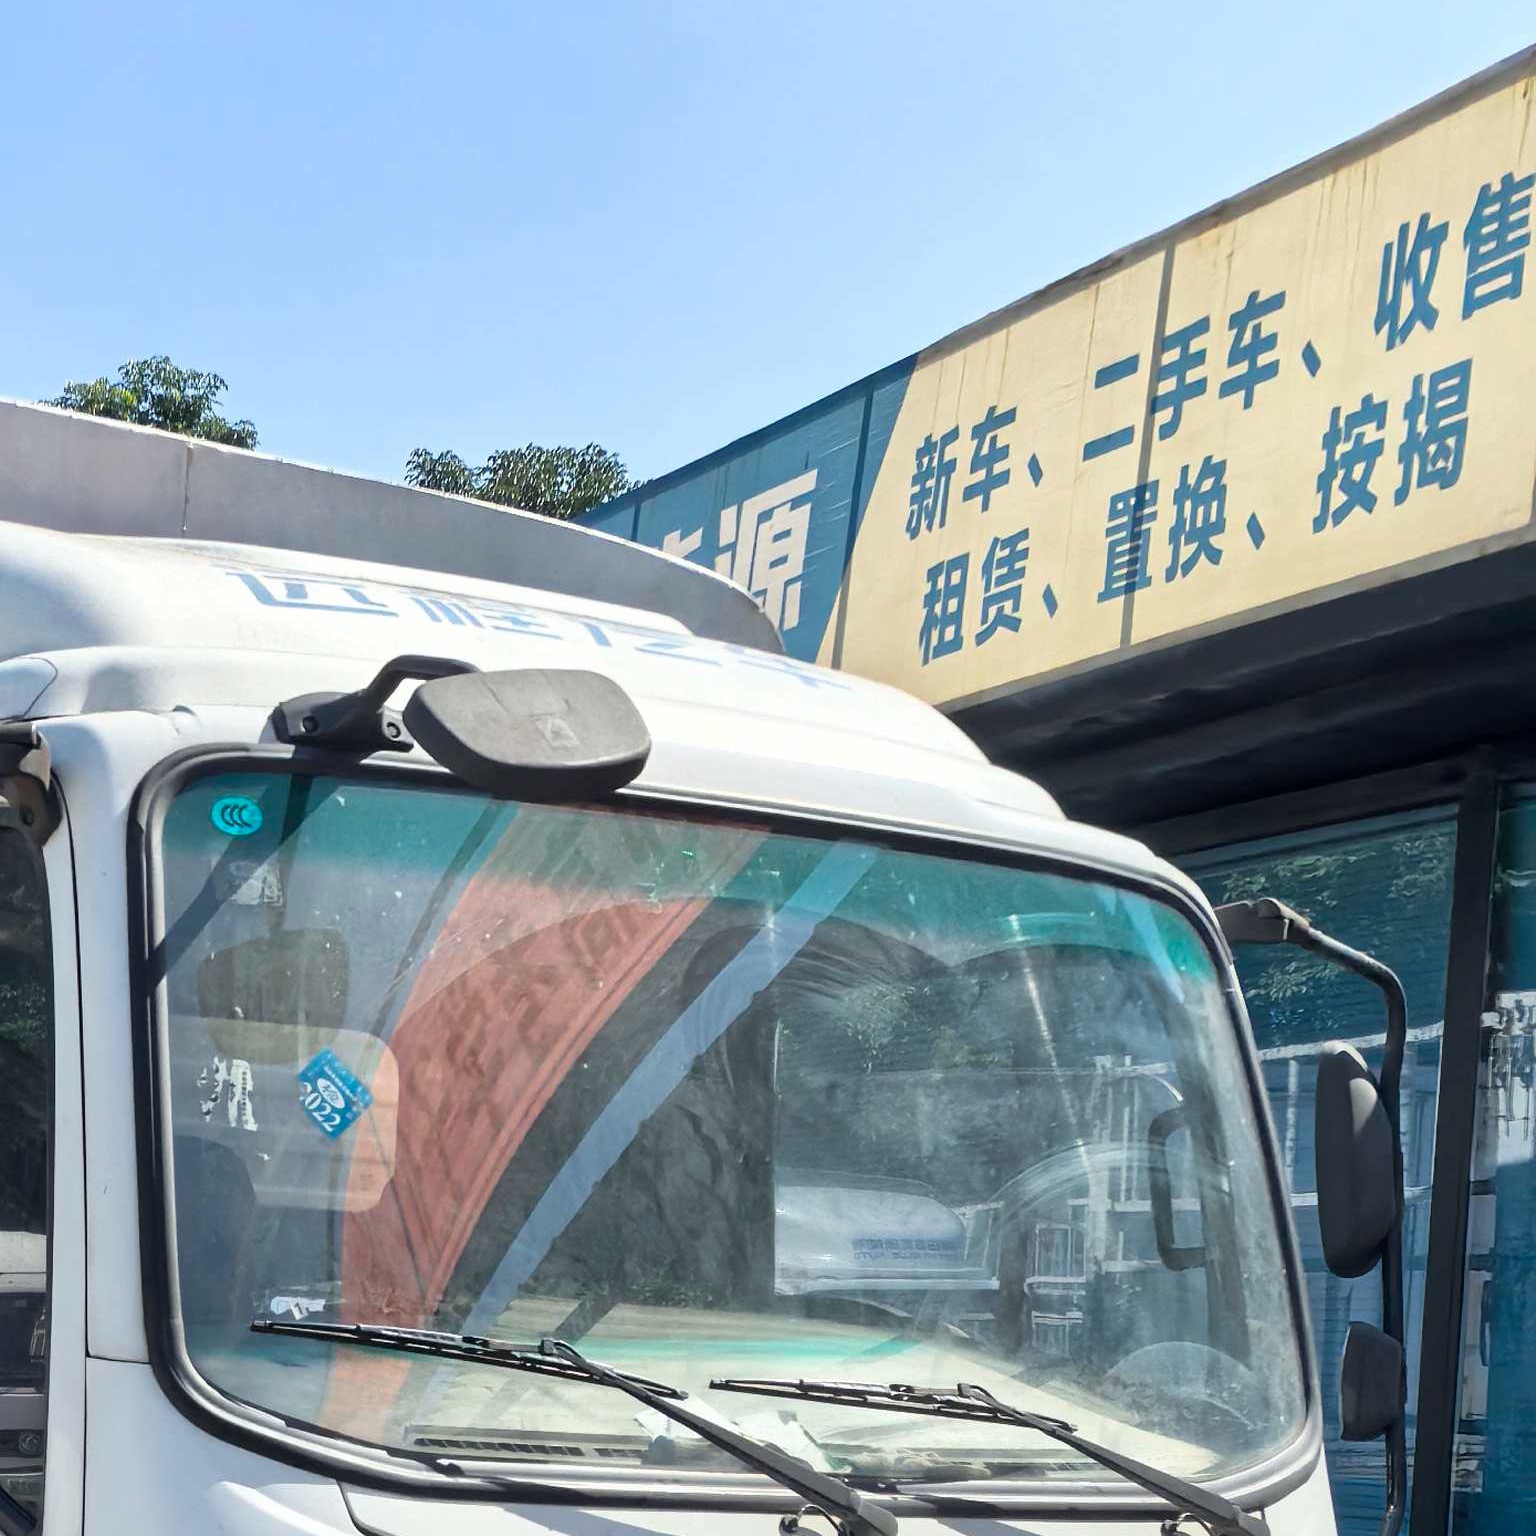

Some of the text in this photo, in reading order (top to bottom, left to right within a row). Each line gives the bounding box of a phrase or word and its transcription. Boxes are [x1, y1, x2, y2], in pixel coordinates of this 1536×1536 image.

[904, 172, 1535, 541] 新车、二手车、收售
[918, 358, 1472, 667] 租赁、置换、按揭
